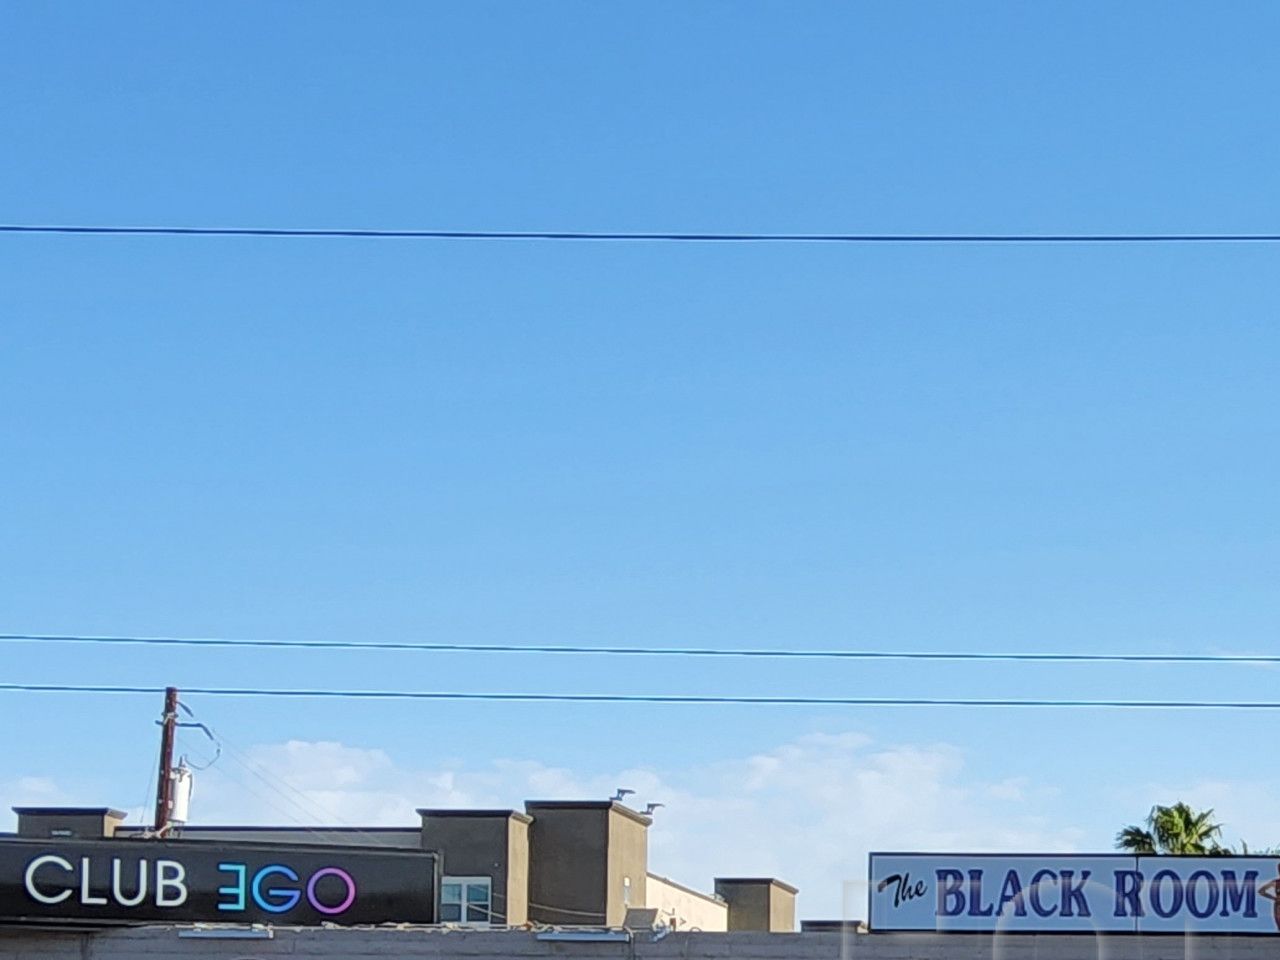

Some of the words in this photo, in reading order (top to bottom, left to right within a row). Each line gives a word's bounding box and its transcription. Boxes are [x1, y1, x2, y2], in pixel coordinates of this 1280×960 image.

[24, 854, 189, 908] CLUB
[877, 872, 929, 909] The
[934, 867, 1092, 918] BLACK
[1113, 869, 1259, 919] ROOM
